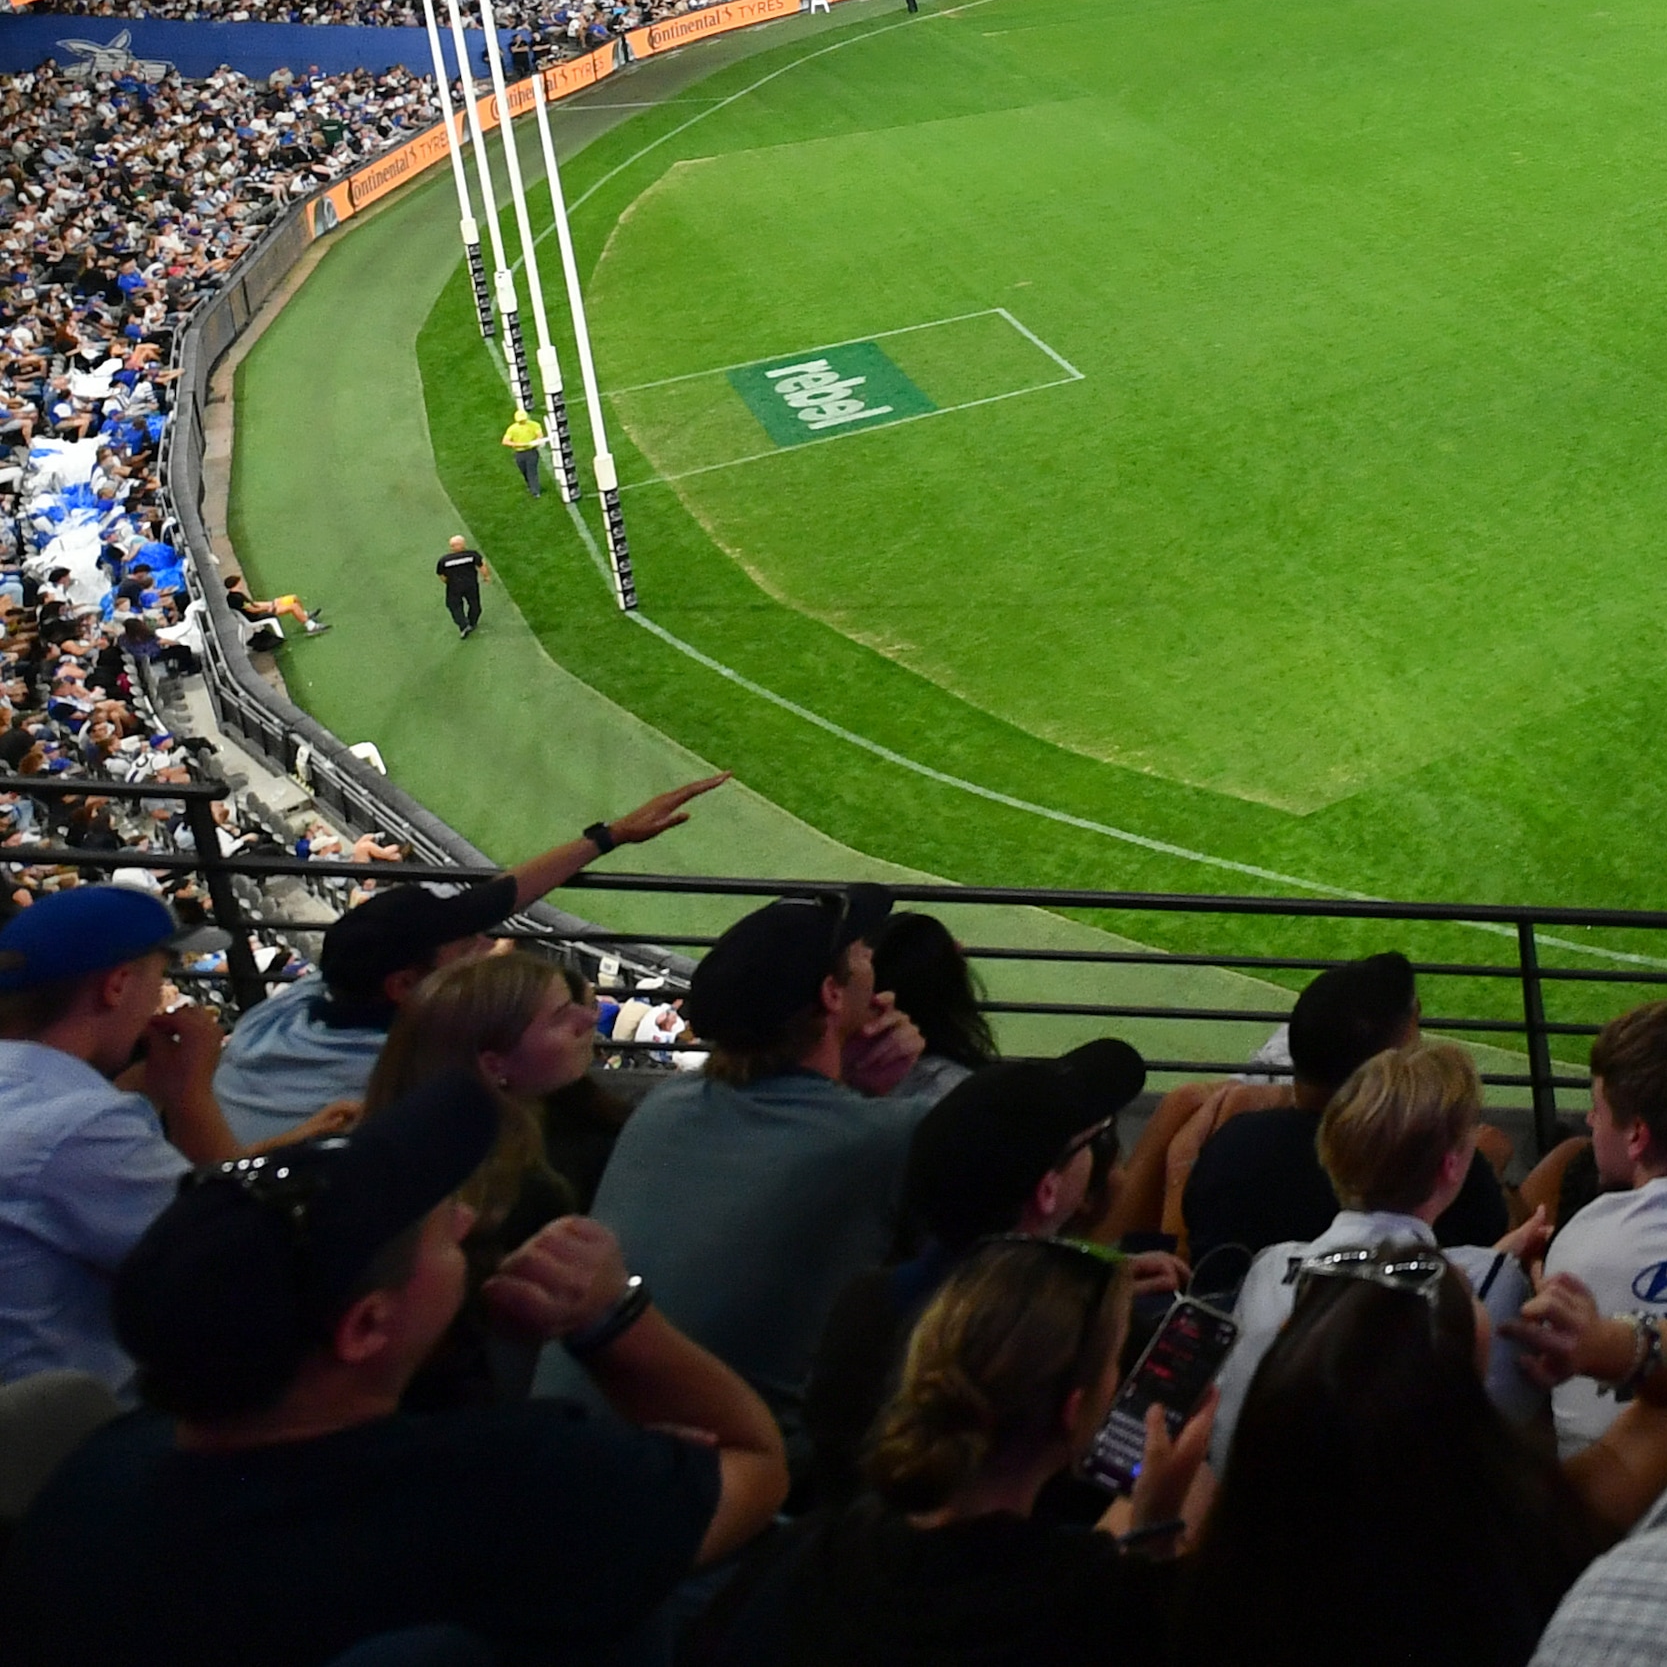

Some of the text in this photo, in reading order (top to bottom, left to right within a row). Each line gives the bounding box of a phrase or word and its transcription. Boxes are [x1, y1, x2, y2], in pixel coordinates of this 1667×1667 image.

[647, 10, 723, 49] Continental
[419, 130, 448, 159] TYRE
[764, 357, 894, 431] rebel
